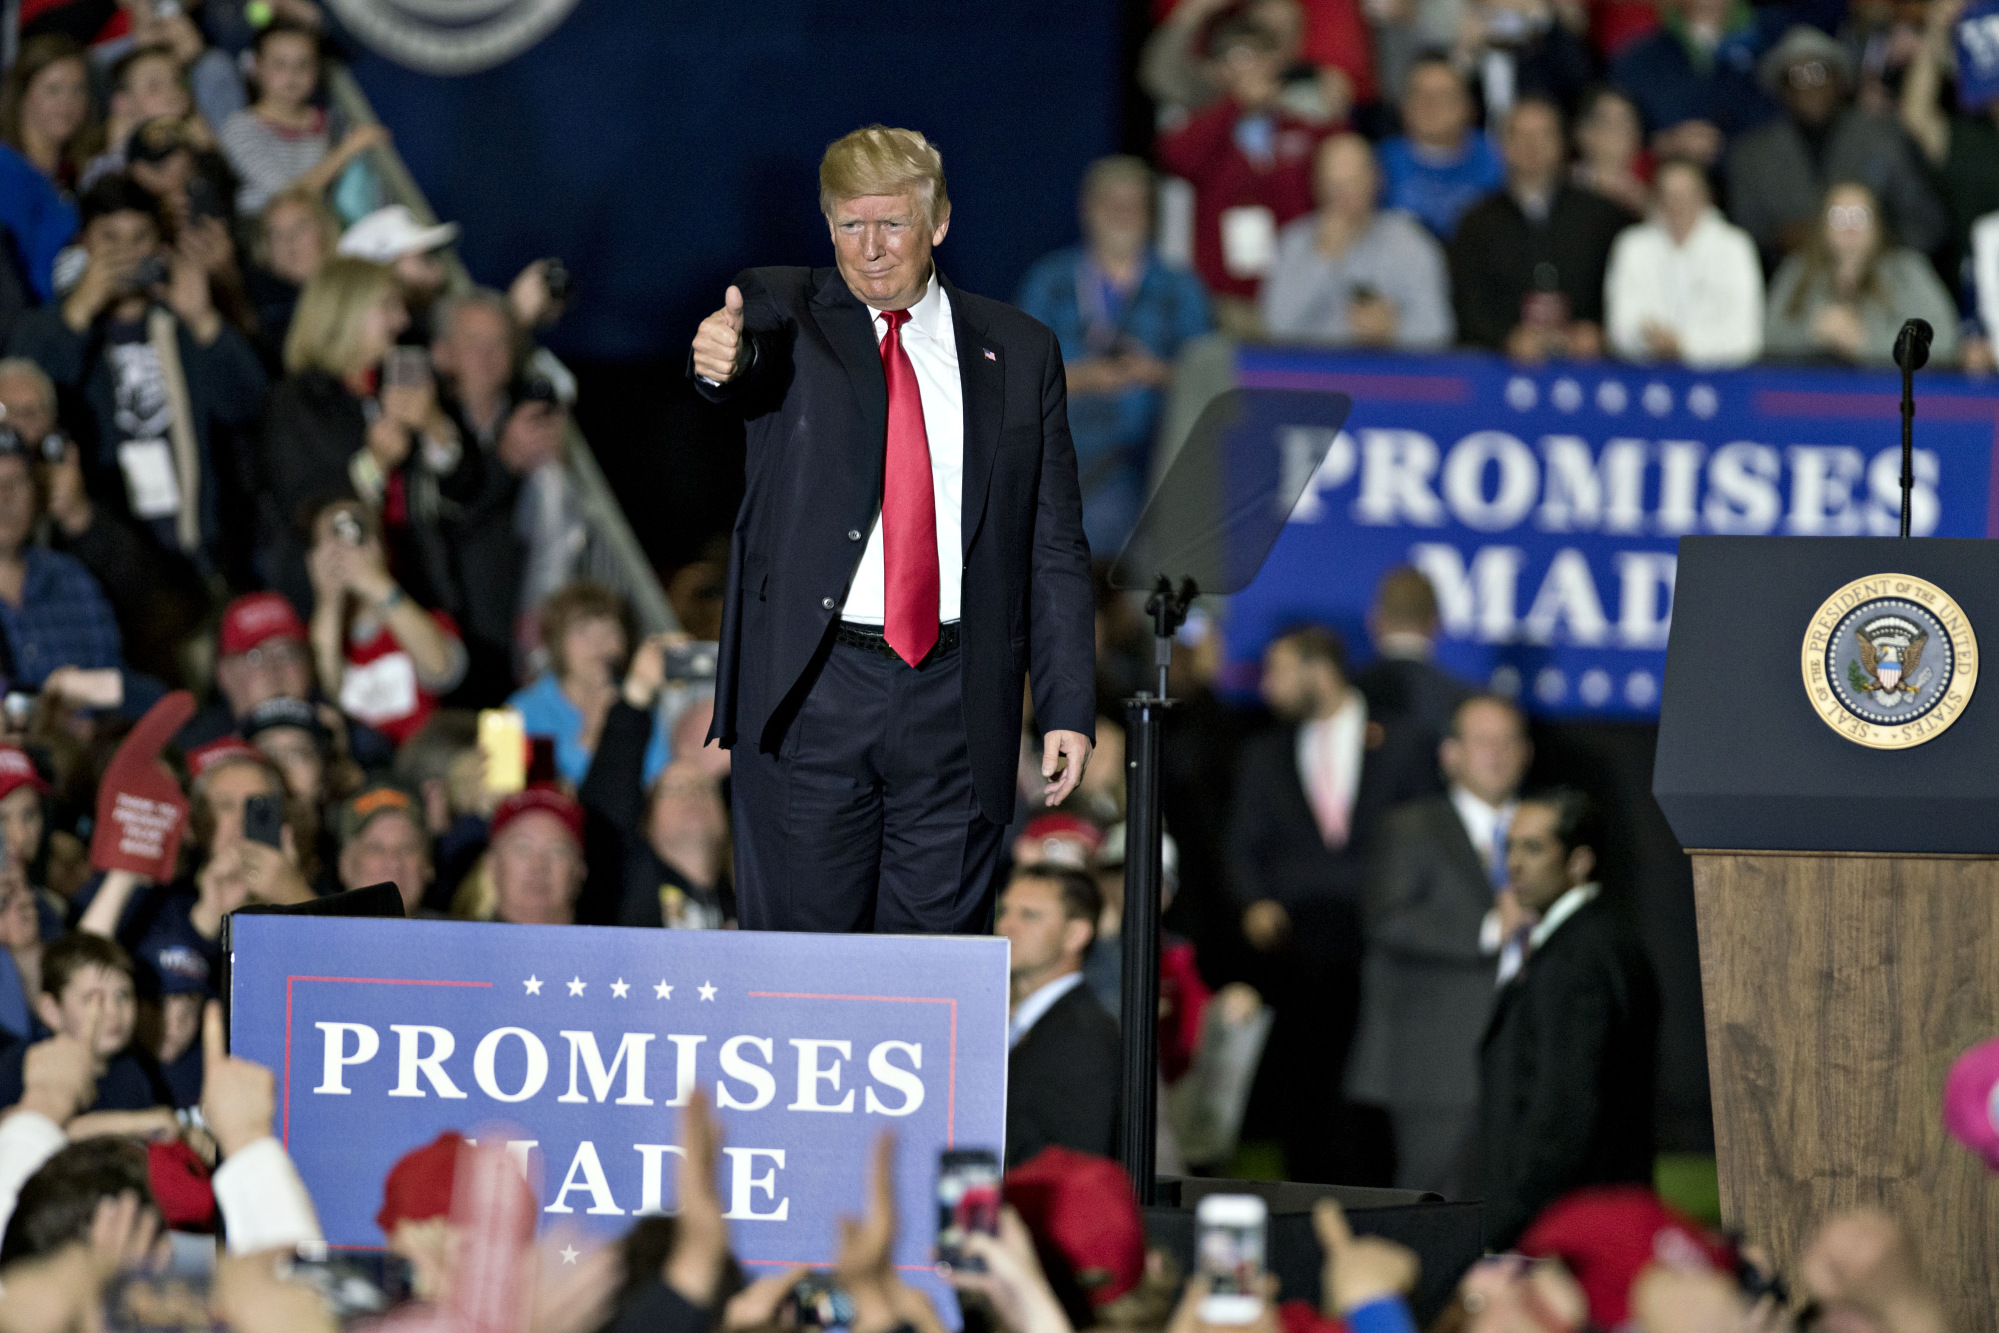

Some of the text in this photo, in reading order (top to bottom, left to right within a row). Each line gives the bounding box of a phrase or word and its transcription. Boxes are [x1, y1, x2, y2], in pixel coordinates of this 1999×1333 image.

[1278, 425, 1940, 537] PROMISES
[1809, 580, 1972, 741] SEAL OF THE PRESIDENT OF THE UNITED STATES
[313, 1021, 925, 1116] PROMISES
